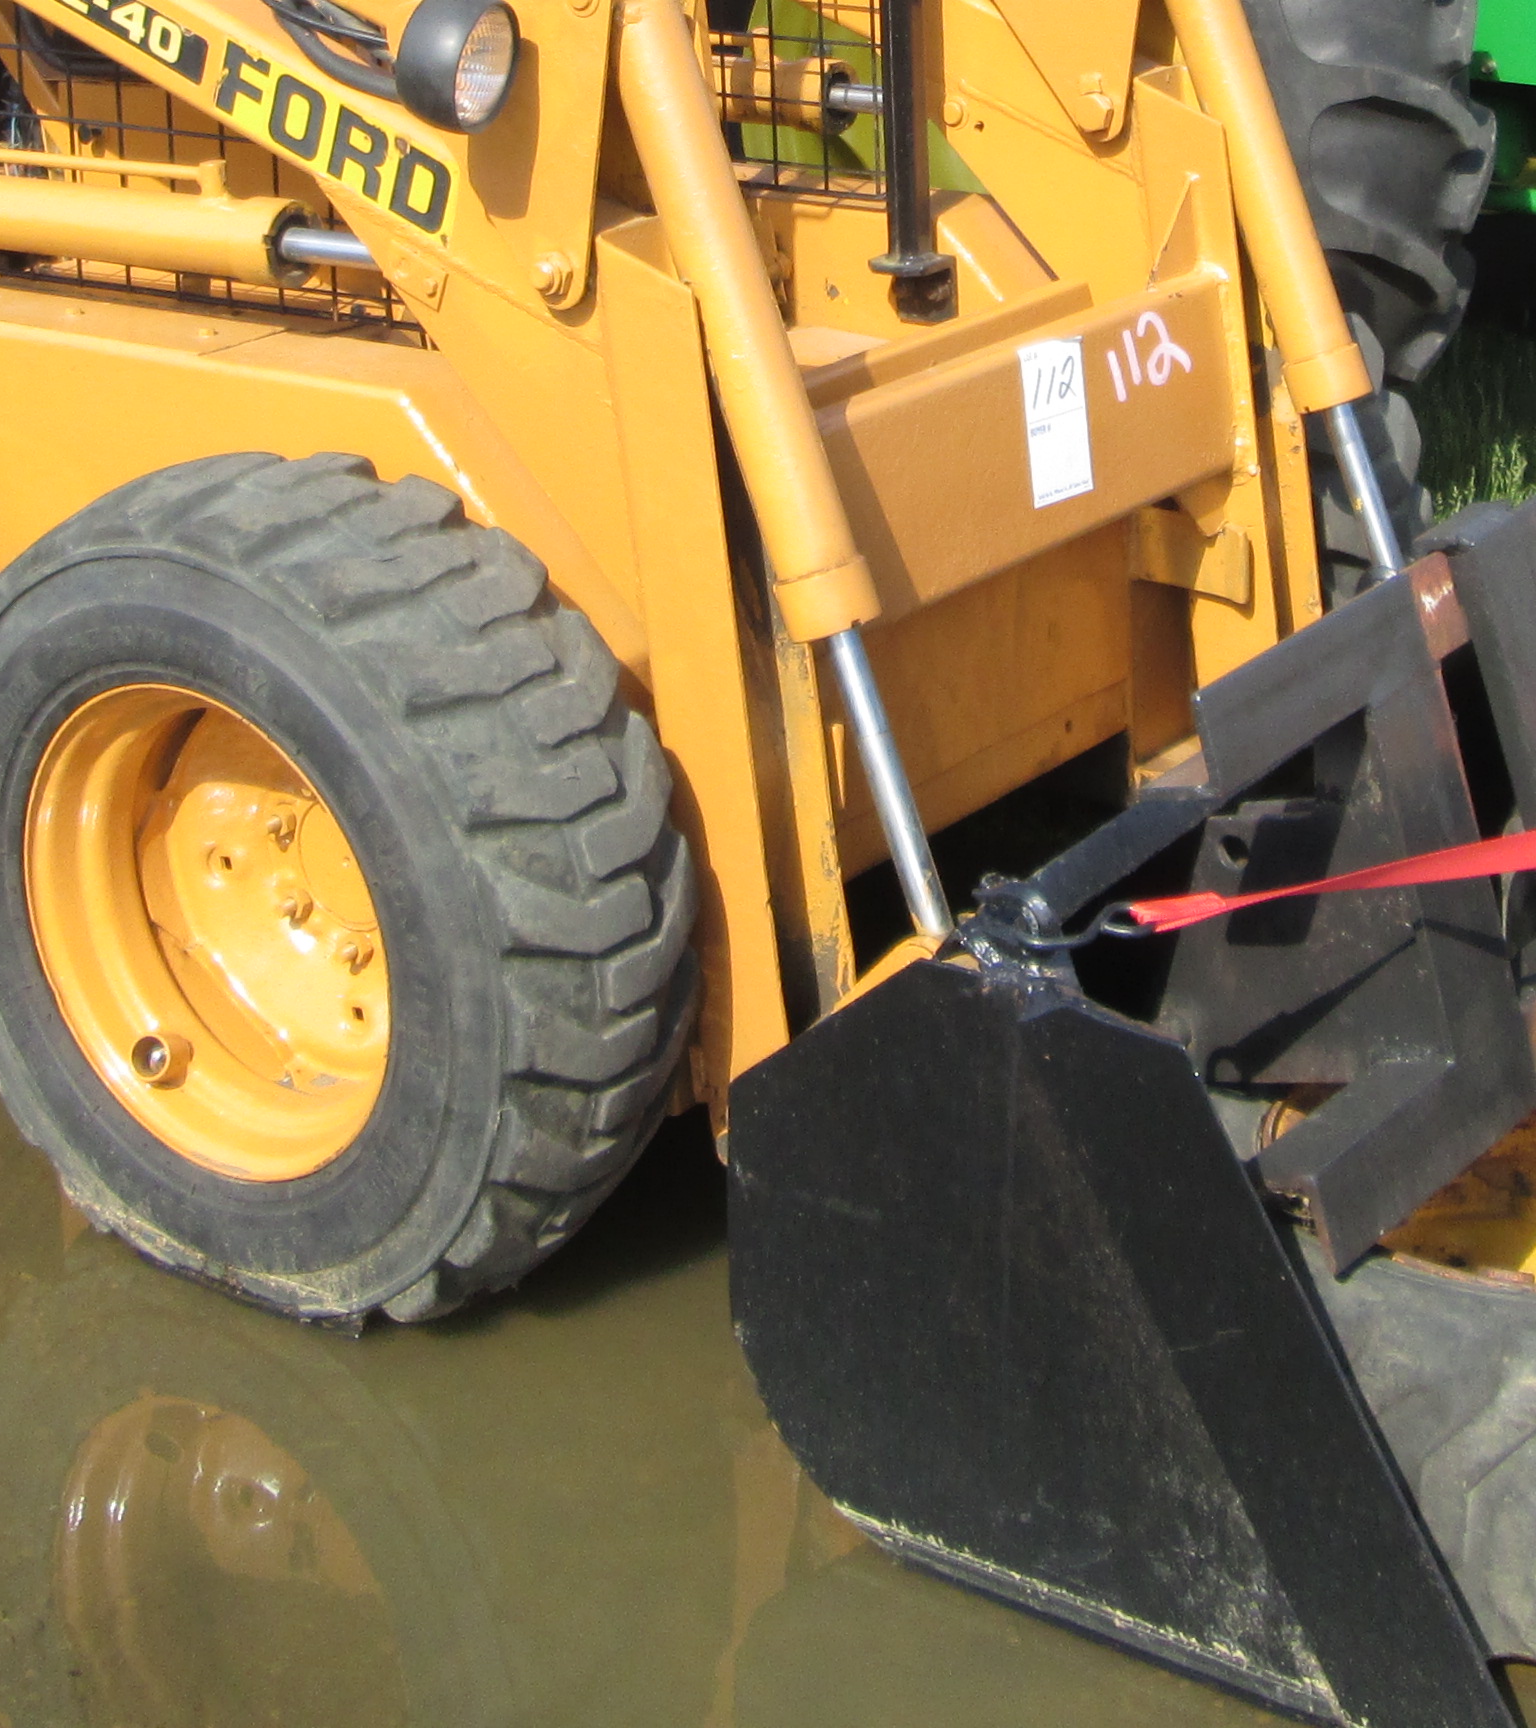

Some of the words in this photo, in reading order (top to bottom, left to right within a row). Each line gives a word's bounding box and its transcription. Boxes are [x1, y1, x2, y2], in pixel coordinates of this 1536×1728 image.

[215, 39, 453, 234] FORD
[1032, 355, 1077, 410] 112
[1106, 311, 1193, 403] 112
